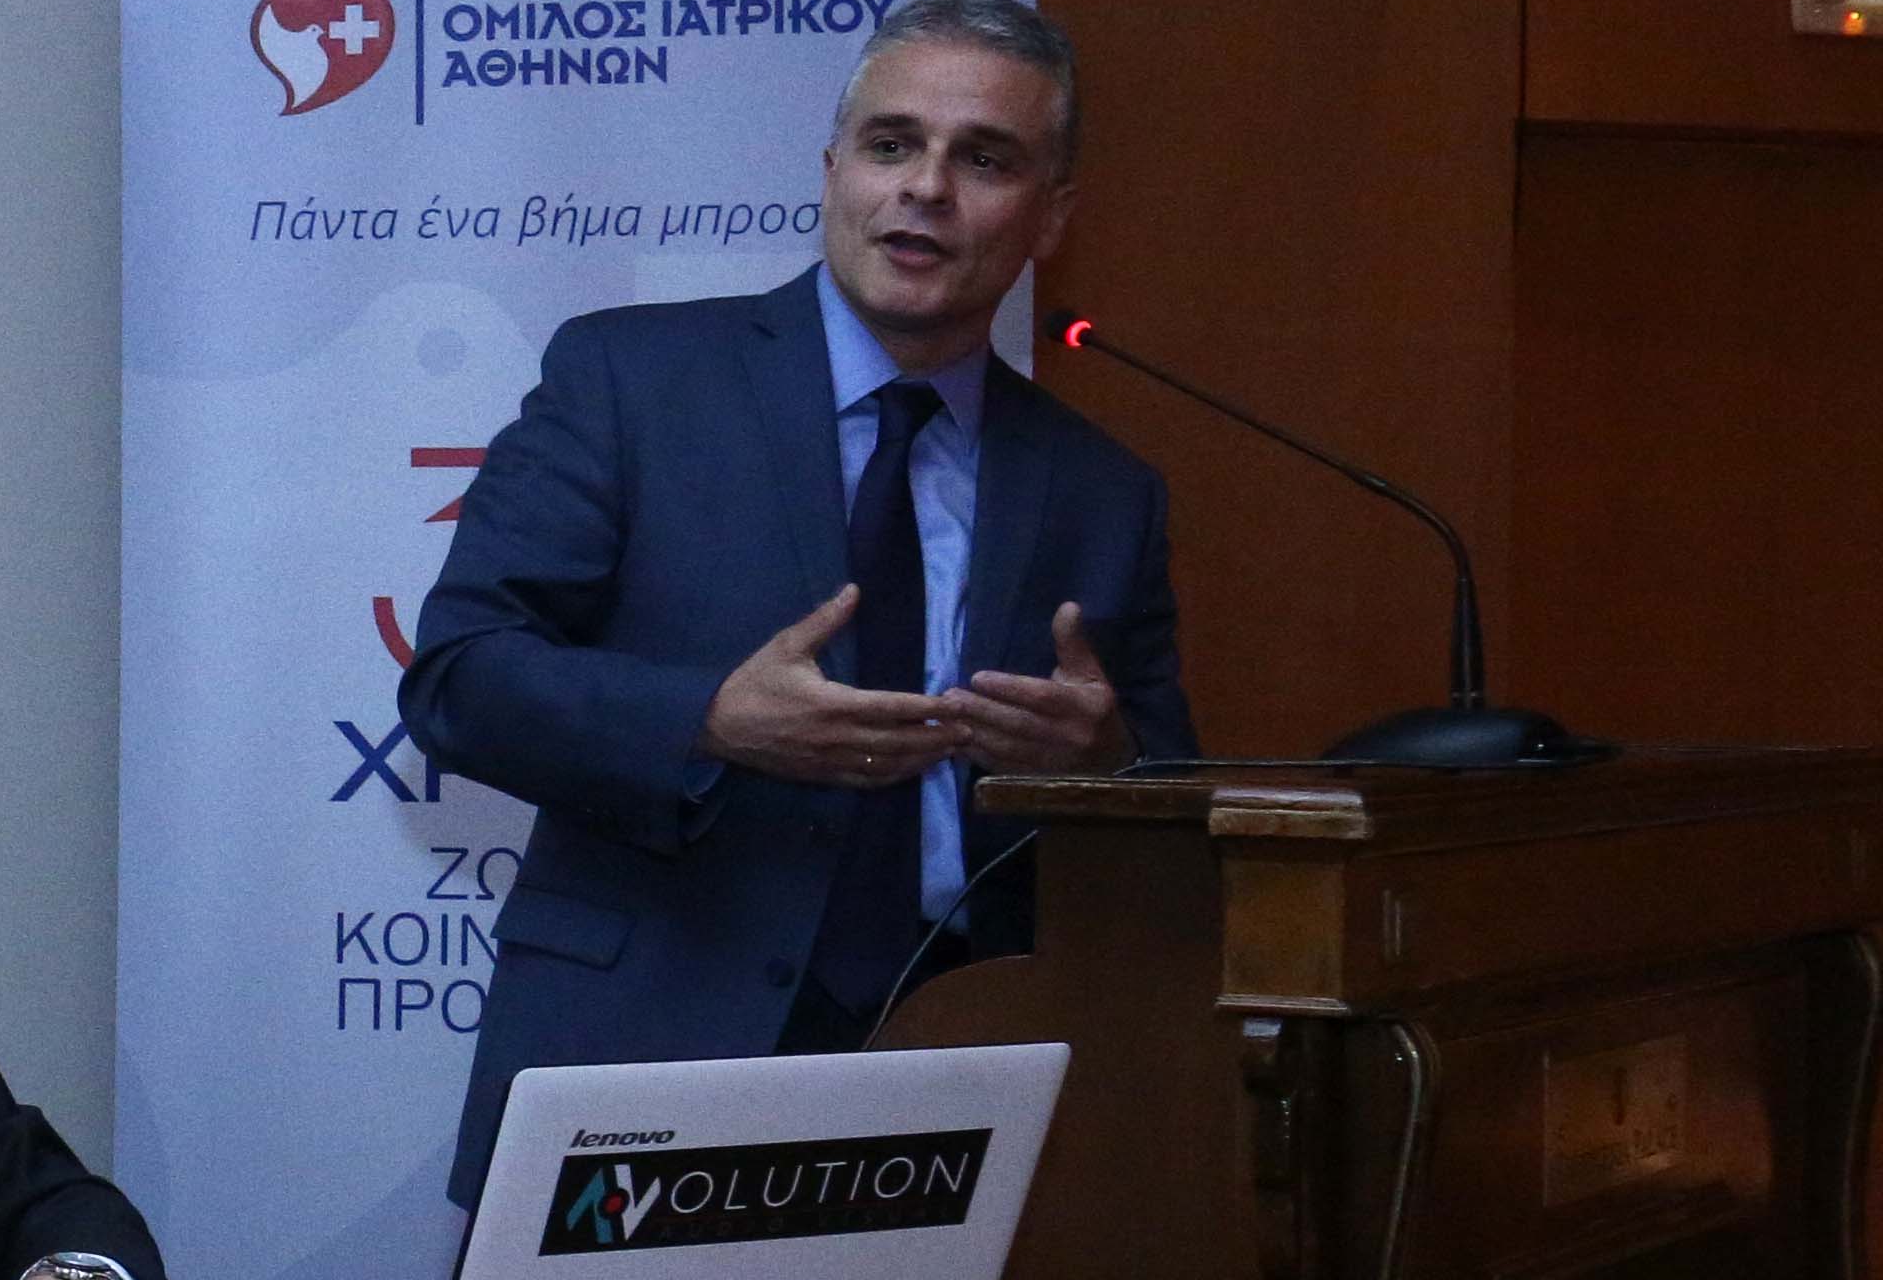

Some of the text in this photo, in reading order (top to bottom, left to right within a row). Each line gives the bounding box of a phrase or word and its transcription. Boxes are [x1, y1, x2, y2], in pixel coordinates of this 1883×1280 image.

[442, 0, 646, 42] ΟΜΙΛΟΣ
[442, 45, 668, 88] ΑΘΗΝΩΝ
[250, 196, 399, 241] Πάντα
[416, 194, 501, 240] ένα
[517, 192, 642, 248] βήμα
[569, 1128, 676, 1150] lenovo
